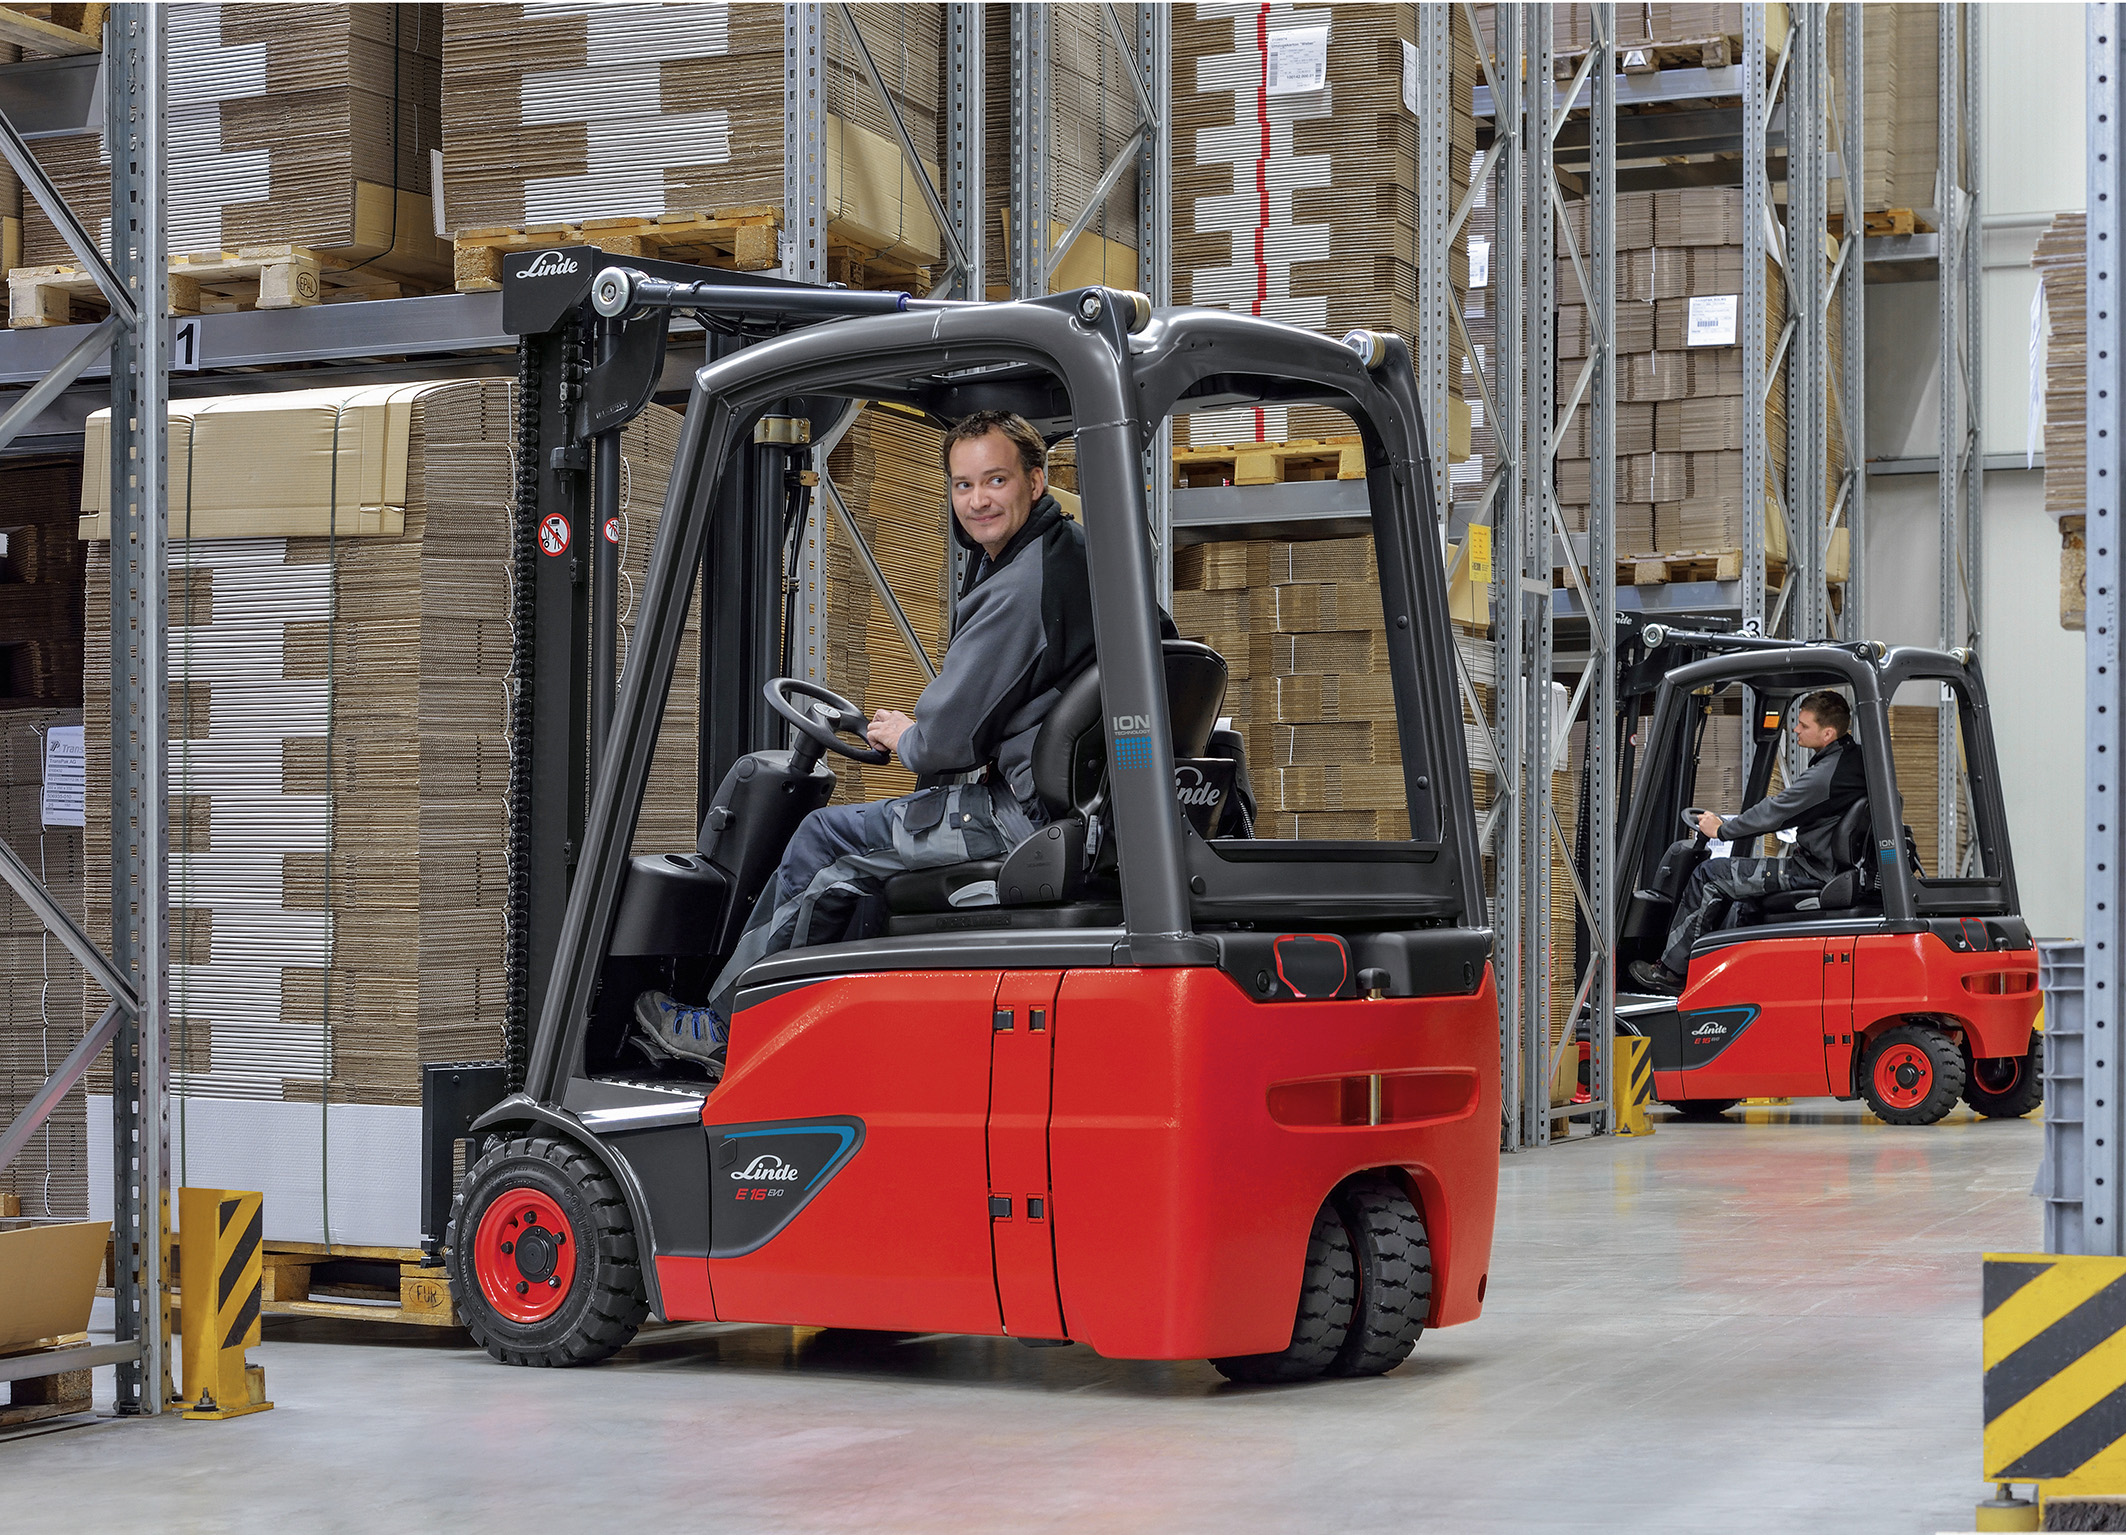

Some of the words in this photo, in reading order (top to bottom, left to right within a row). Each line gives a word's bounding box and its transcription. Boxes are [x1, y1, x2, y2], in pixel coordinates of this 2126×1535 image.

[516, 251, 578, 279] Linde
[300, 276, 314, 294] EPAL
[176, 323, 194, 365] 1
[1746, 620, 1760, 638] 3
[1113, 714, 1151, 731] ION
[1878, 839, 1895, 847] ION
[1691, 1021, 1727, 1036] Linde
[731, 1154, 798, 1181] Linde
[735, 1188, 749, 1200] E
[750, 1188, 768, 1200] 16
[767, 1188, 785, 1197] EVO
